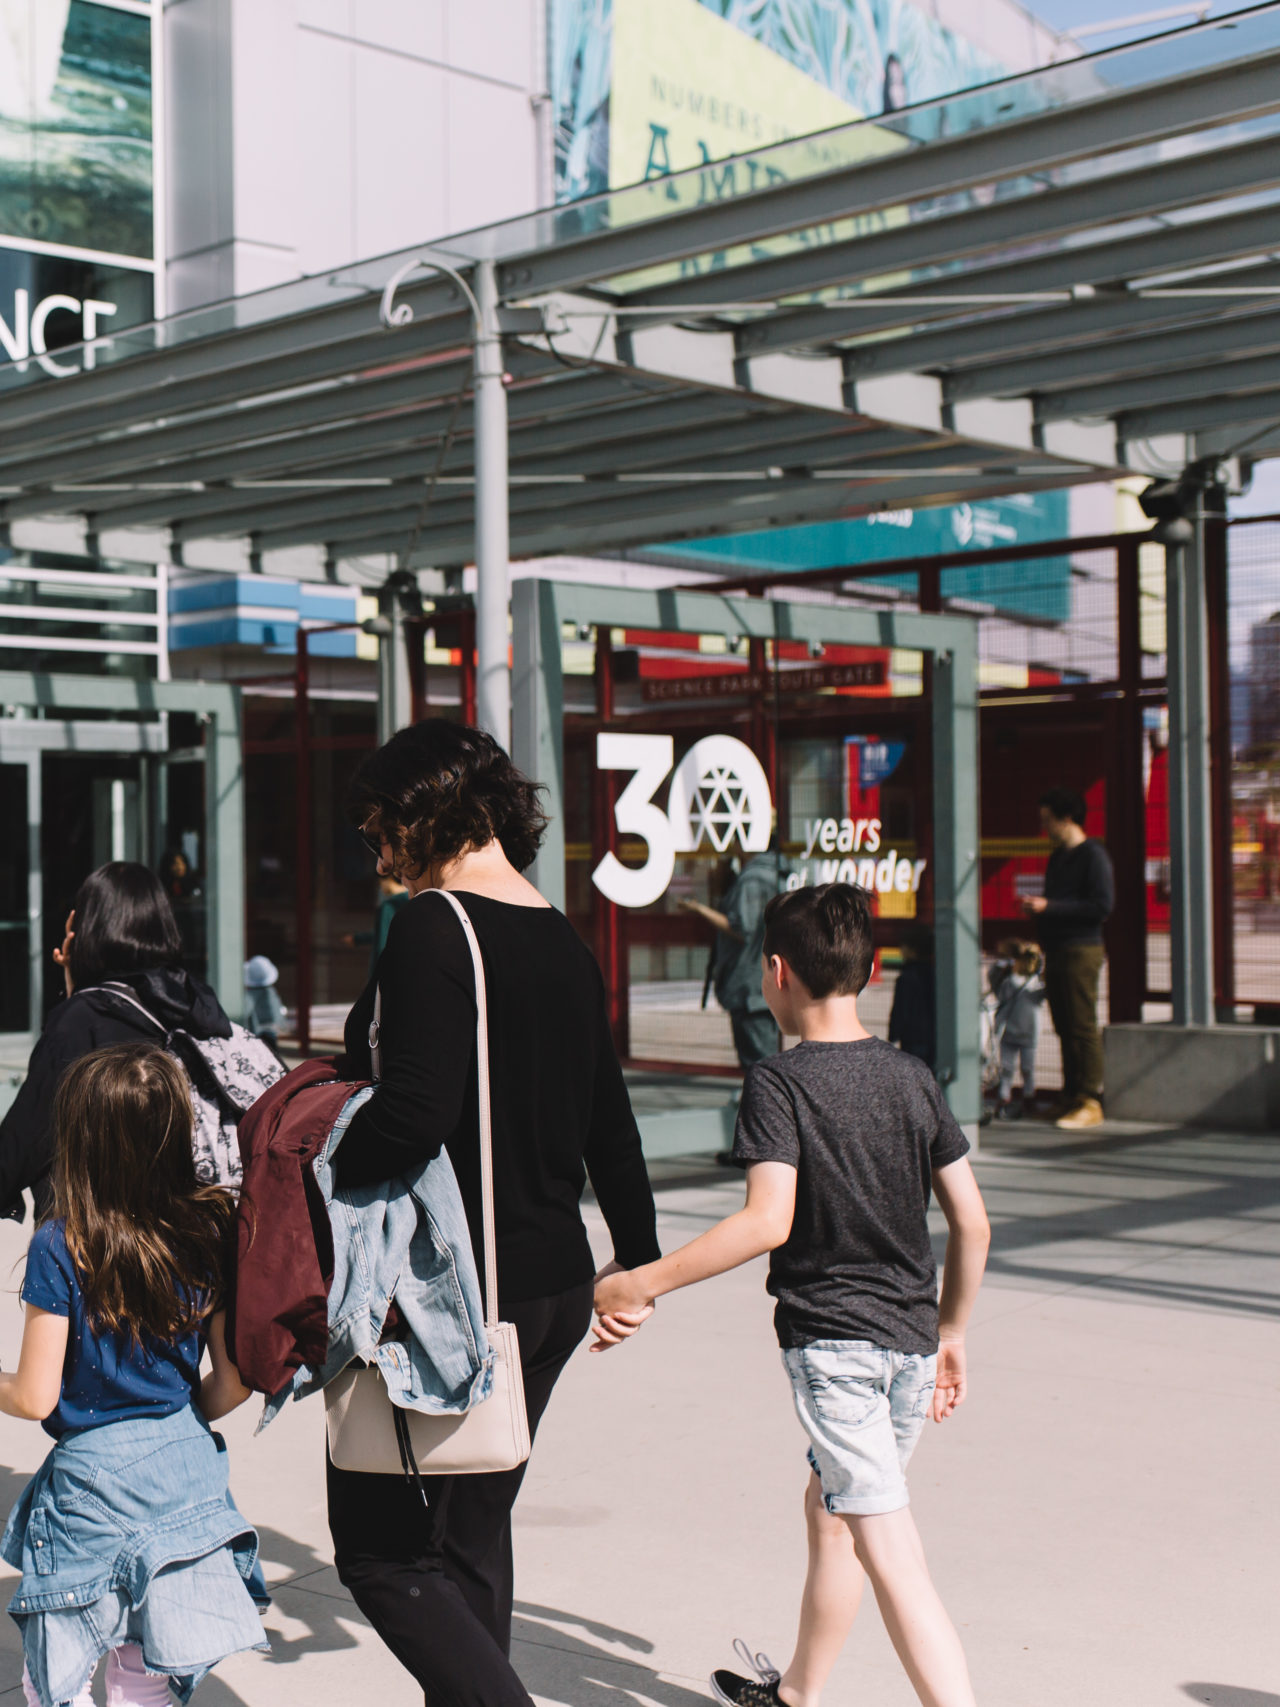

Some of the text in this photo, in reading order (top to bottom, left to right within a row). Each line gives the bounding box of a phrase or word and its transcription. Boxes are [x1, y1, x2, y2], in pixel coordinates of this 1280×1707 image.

[648, 678, 713, 700] SCIENCE
[719, 674, 763, 694] PARK
[832, 665, 875, 685] GATE
[591, 731, 772, 908] 30
[800, 817, 882, 860] years
[813, 849, 928, 894] wonder
